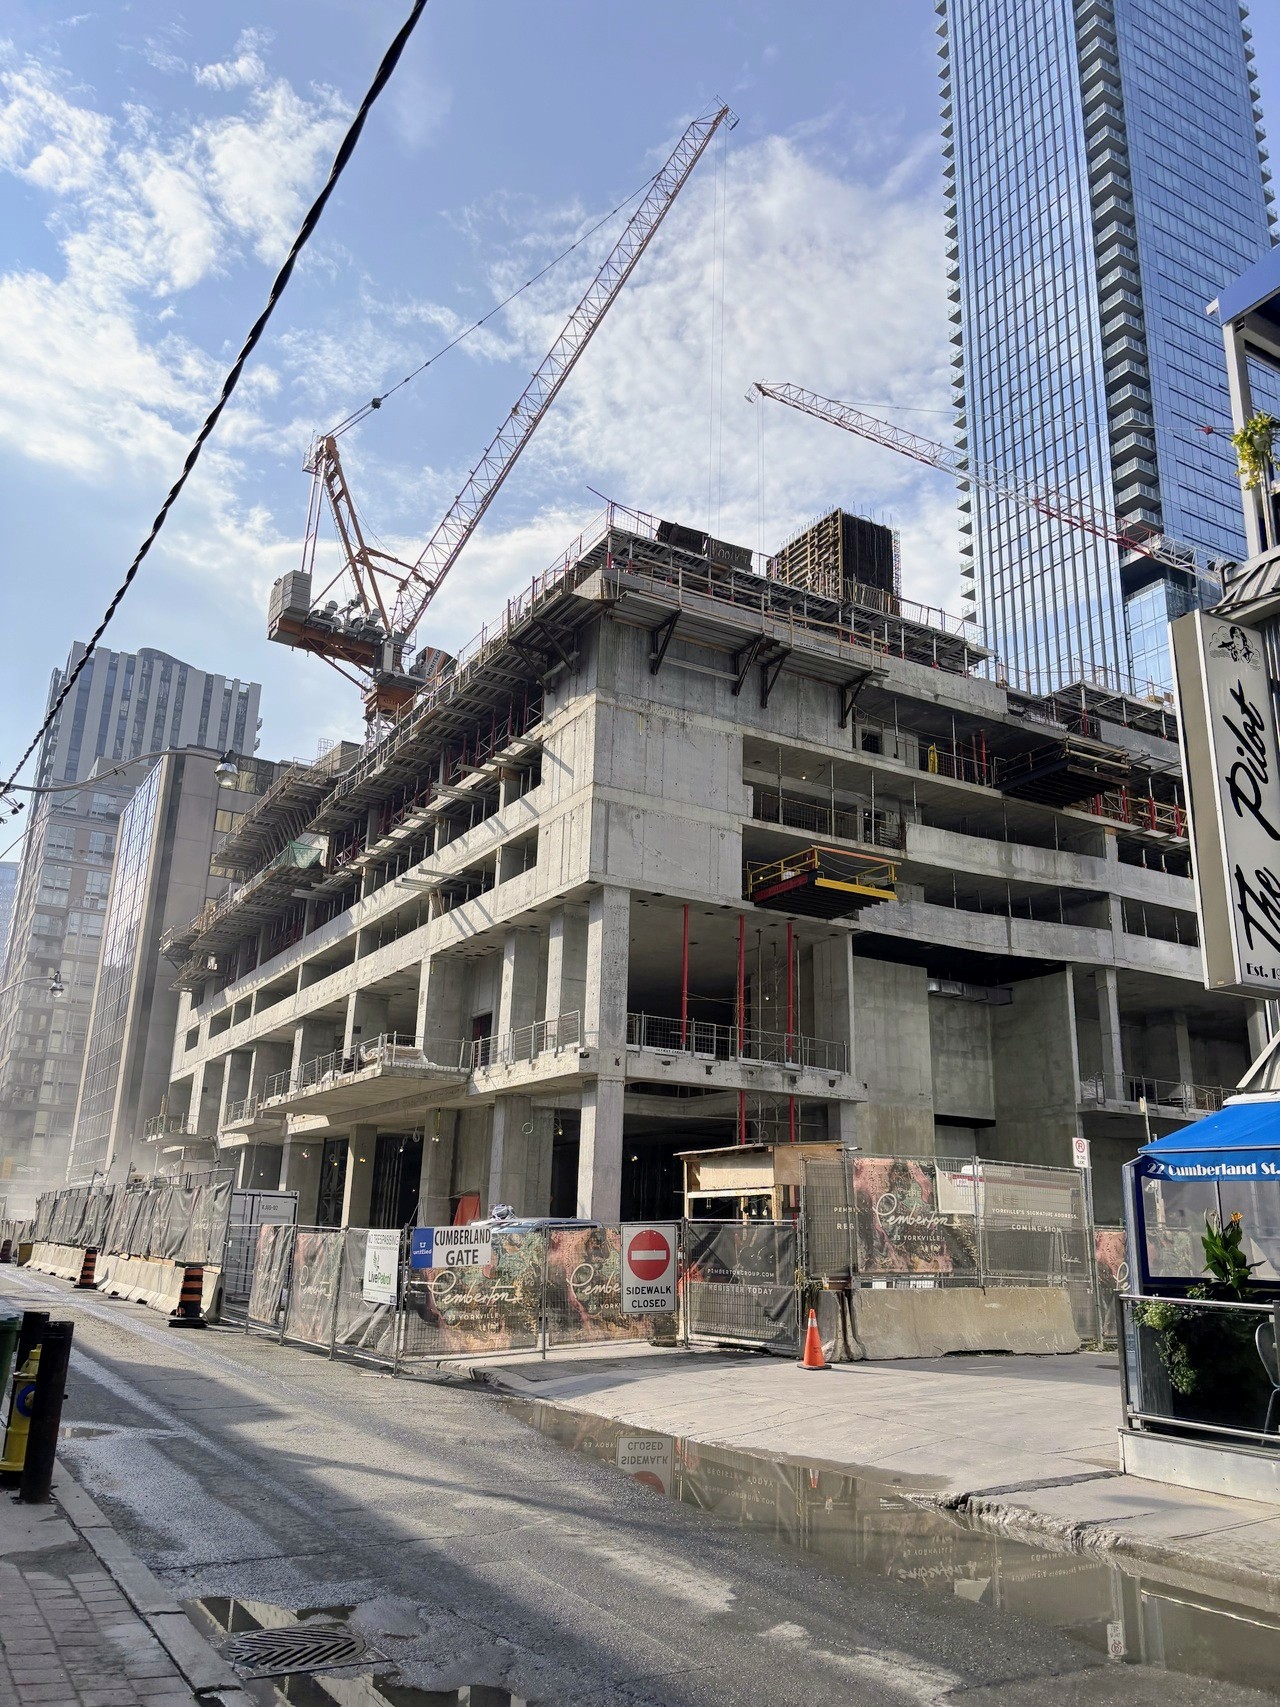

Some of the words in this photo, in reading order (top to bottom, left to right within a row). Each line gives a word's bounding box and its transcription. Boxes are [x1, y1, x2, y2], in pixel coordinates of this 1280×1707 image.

[1222, 678, 1280, 841] Pilot
[1246, 962, 1269, 979] Est.
[1147, 1163, 1165, 1175] 22
[1168, 1162, 1257, 1176] Cumberland
[1261, 1162, 1280, 1175] St.
[872, 1193, 961, 1228] Pemberton
[1011, 1223, 1042, 1232] COMING
[434, 1228, 491, 1246] CUMBERLAND
[446, 1249, 479, 1266] GATE
[368, 1270, 392, 1286] LivePatrol
[427, 1270, 523, 1306] Pemberton
[626, 1285, 672, 1295] SIDEWALK
[708, 1284, 745, 1294] REGISTER
[747, 1287, 773, 1296] TODAY
[631, 1298, 667, 1309] CLOSED
[459, 1312, 500, 1321] YORKVILLE
